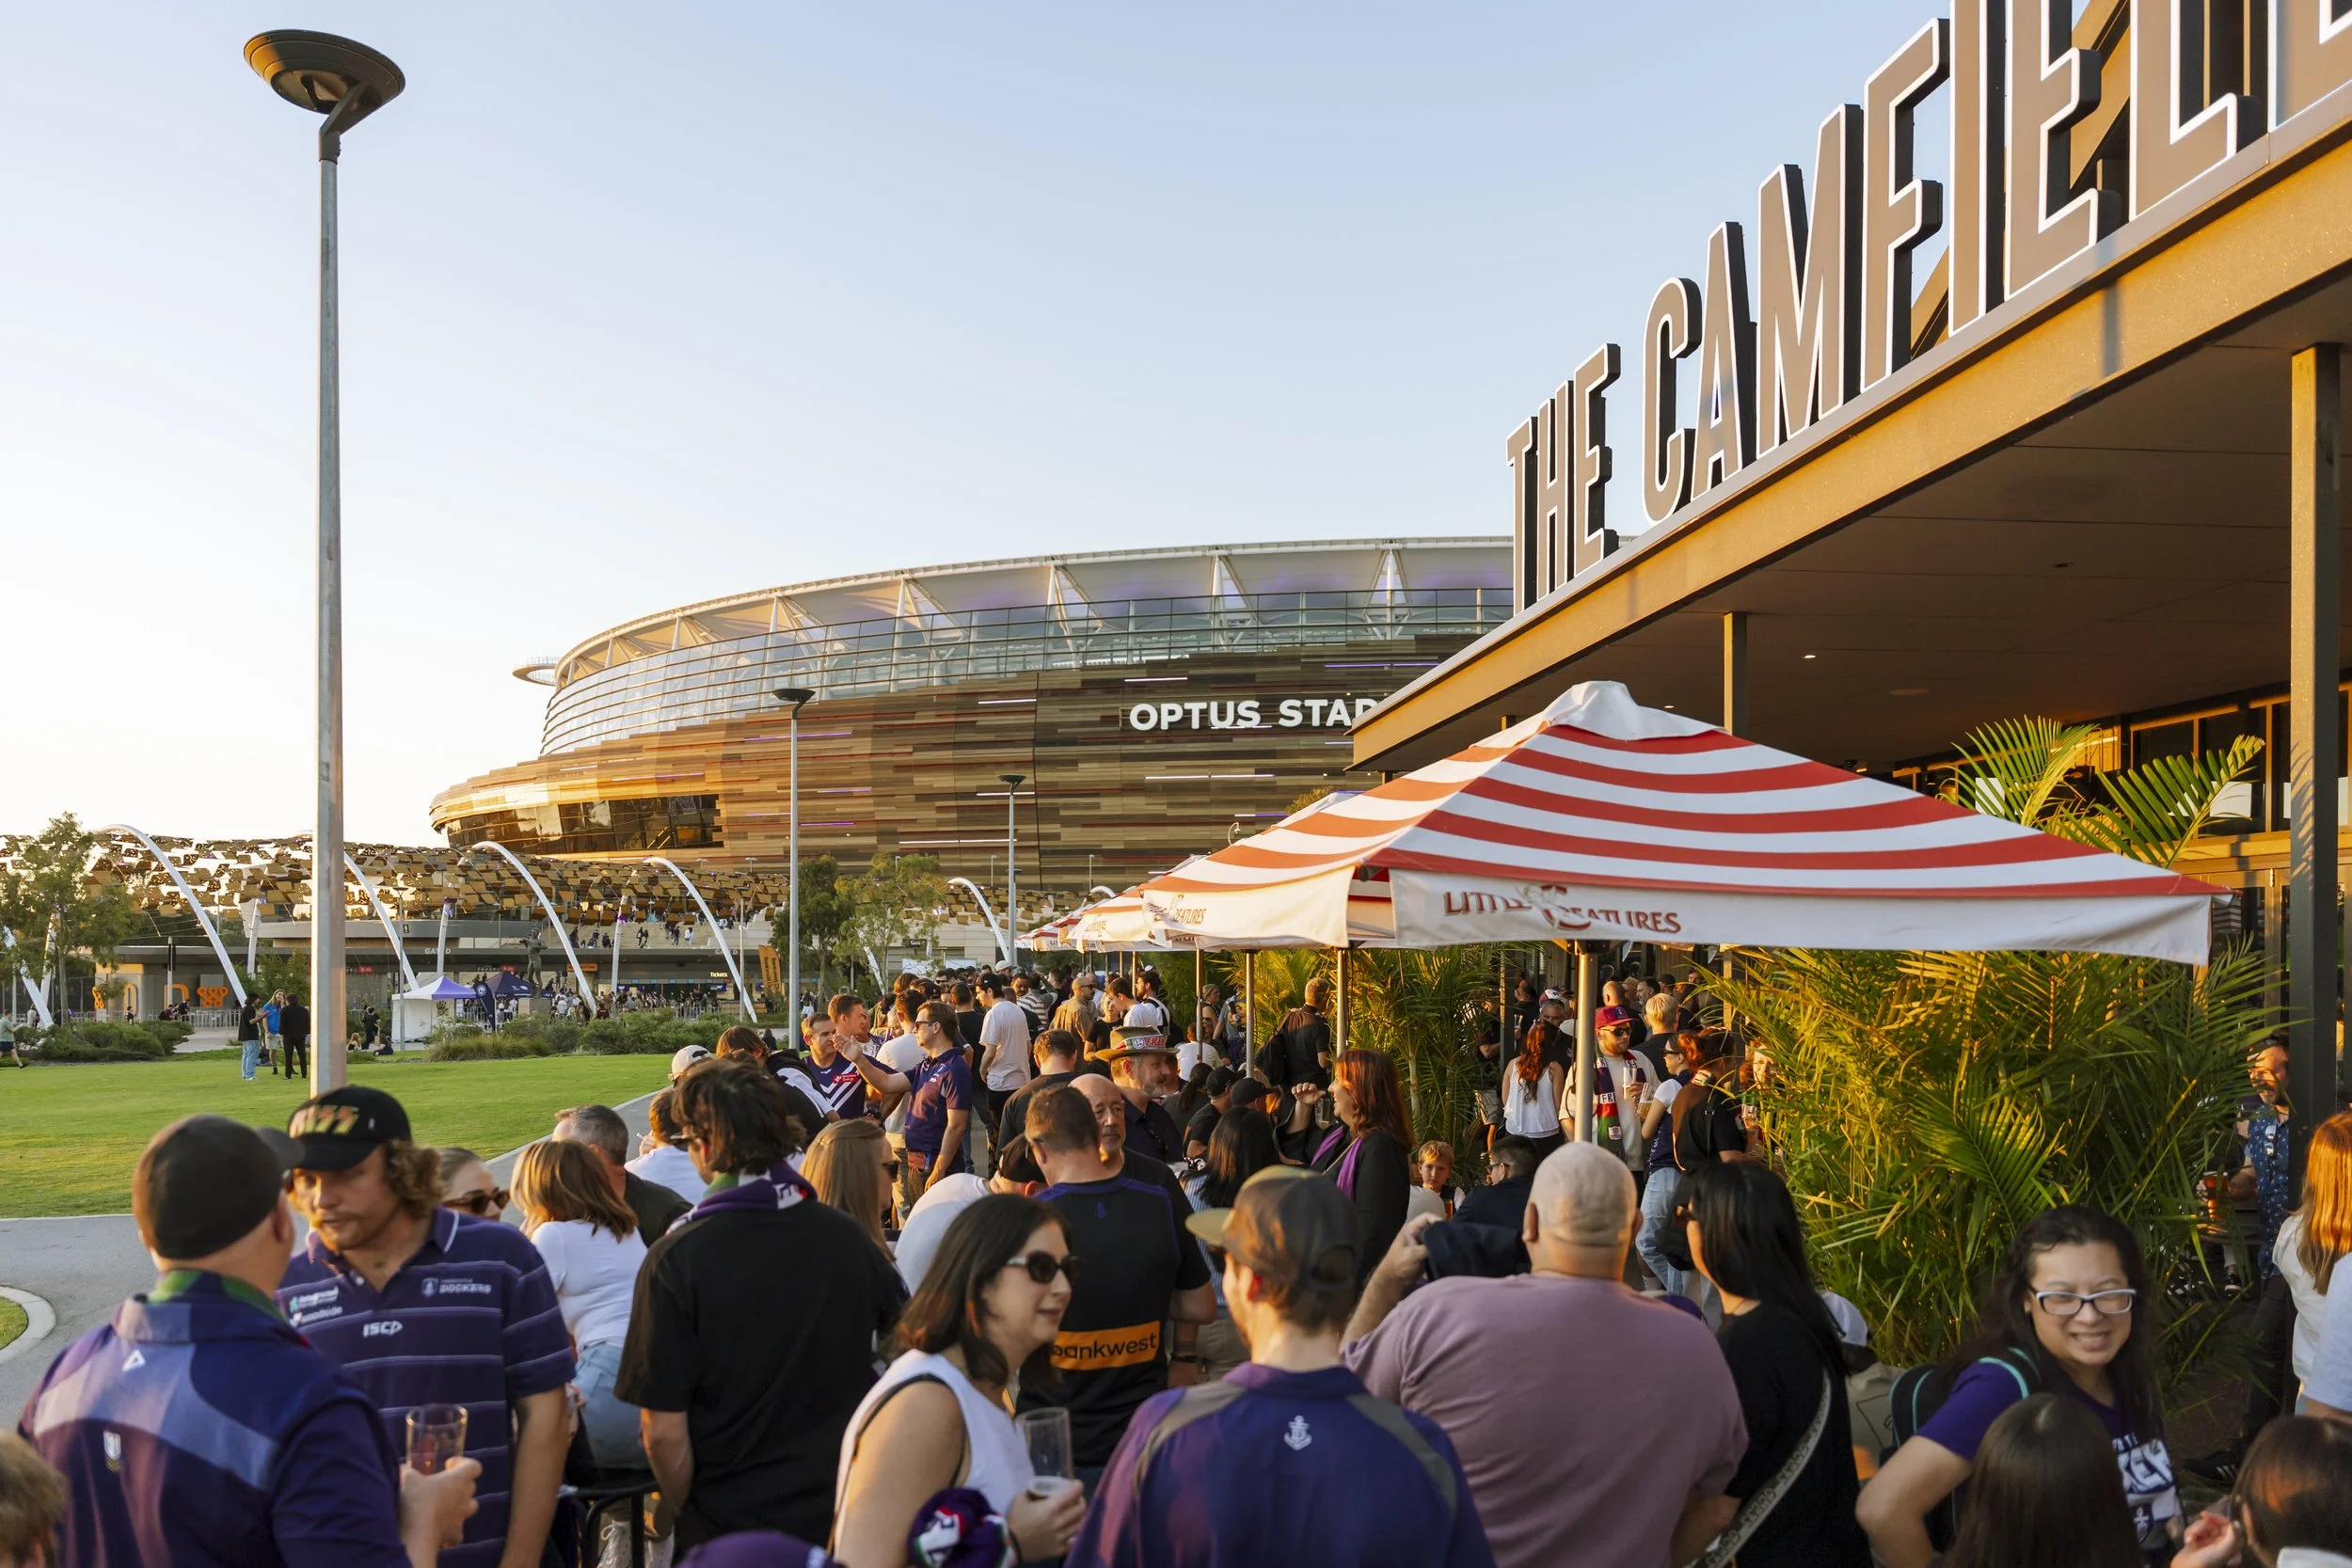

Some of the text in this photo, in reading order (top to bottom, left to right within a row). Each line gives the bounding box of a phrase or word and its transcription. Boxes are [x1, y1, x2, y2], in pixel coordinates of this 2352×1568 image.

[1505, 342, 1613, 619] THE
[1129, 701, 1262, 731] OPTUS
[289, 1104, 359, 1138] KISS
[438, 1284, 492, 1294] DOCKERS
